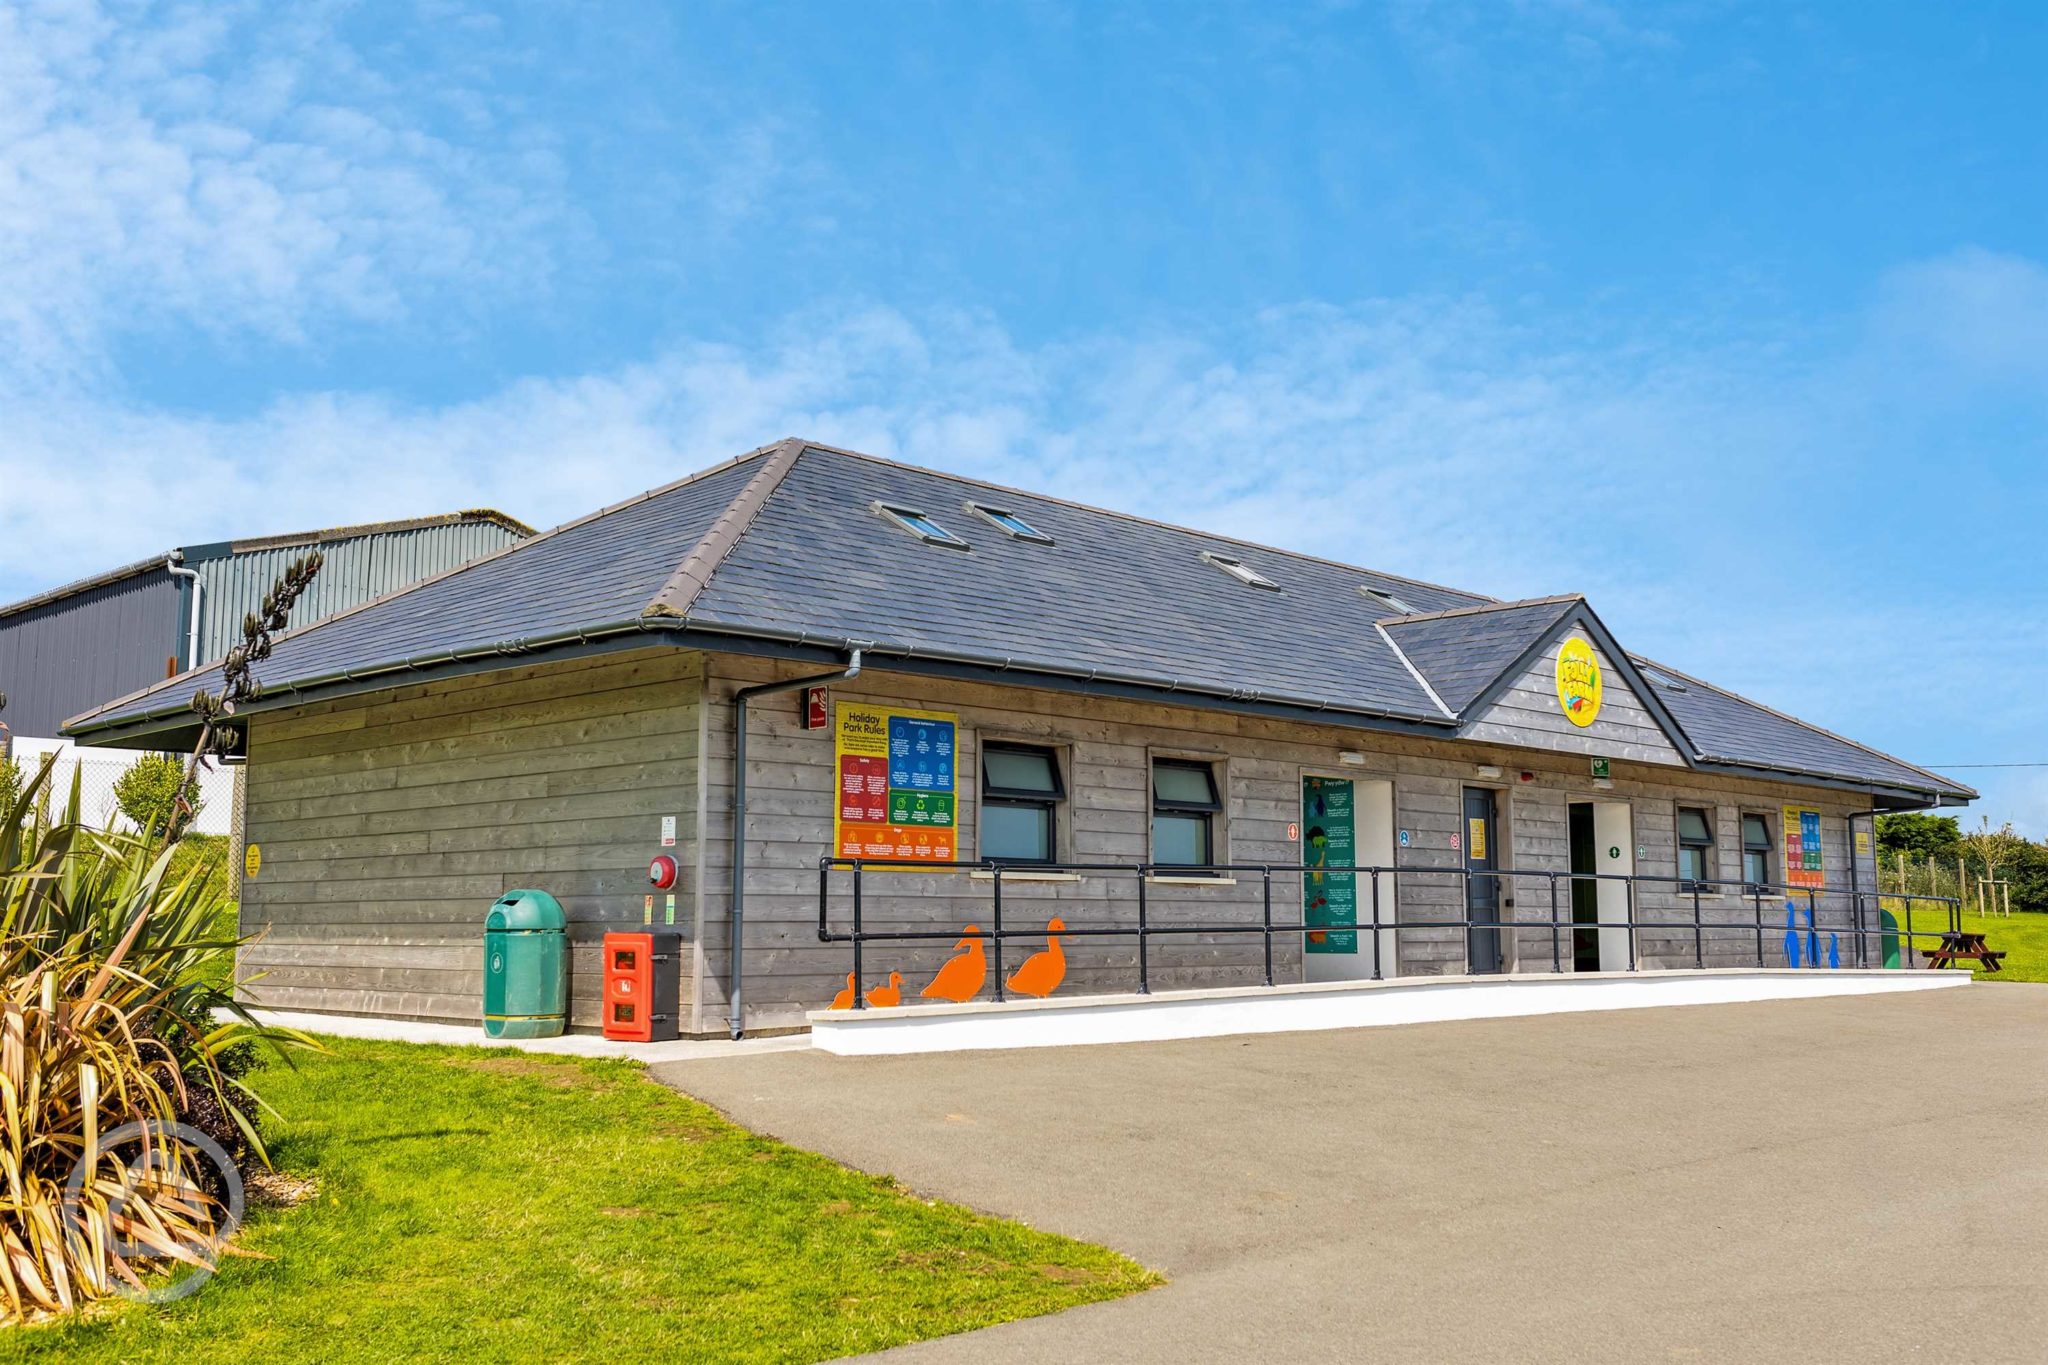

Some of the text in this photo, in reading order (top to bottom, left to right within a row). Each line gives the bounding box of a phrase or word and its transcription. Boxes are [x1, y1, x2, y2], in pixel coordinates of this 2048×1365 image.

[849, 712, 880, 726] Holiday
[843, 722, 885, 735] Park Rules
